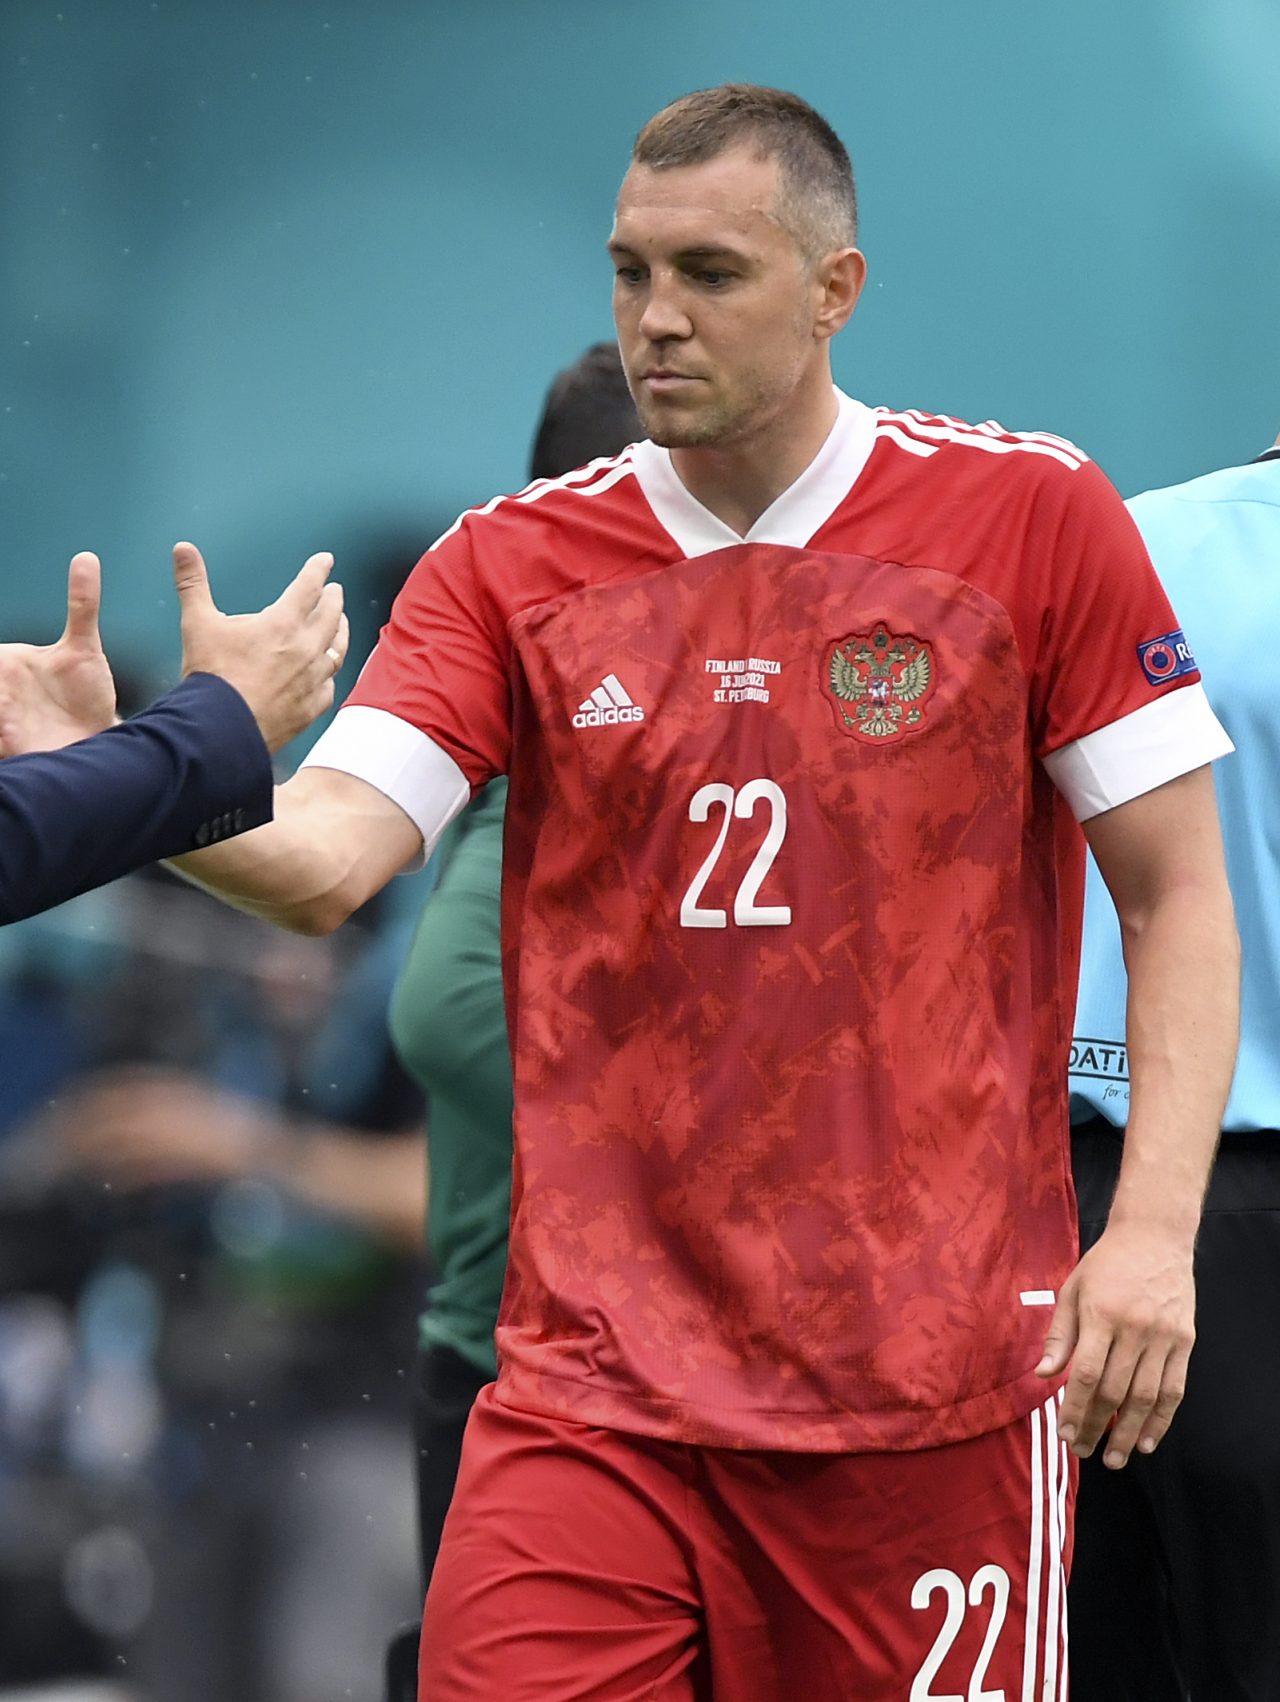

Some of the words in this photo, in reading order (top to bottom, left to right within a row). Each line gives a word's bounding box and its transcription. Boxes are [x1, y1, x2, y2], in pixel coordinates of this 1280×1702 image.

[705, 659, 745, 673] FINLAND
[748, 657, 781, 674] RUSSIA
[720, 674, 731, 688] 16
[745, 672, 765, 687] 2021
[713, 689, 728, 703] ST.
[572, 706, 645, 728] adidas
[680, 778, 792, 928] 22
[1102, 1084, 1120, 1100] for
[909, 1563, 1011, 1702] 22
